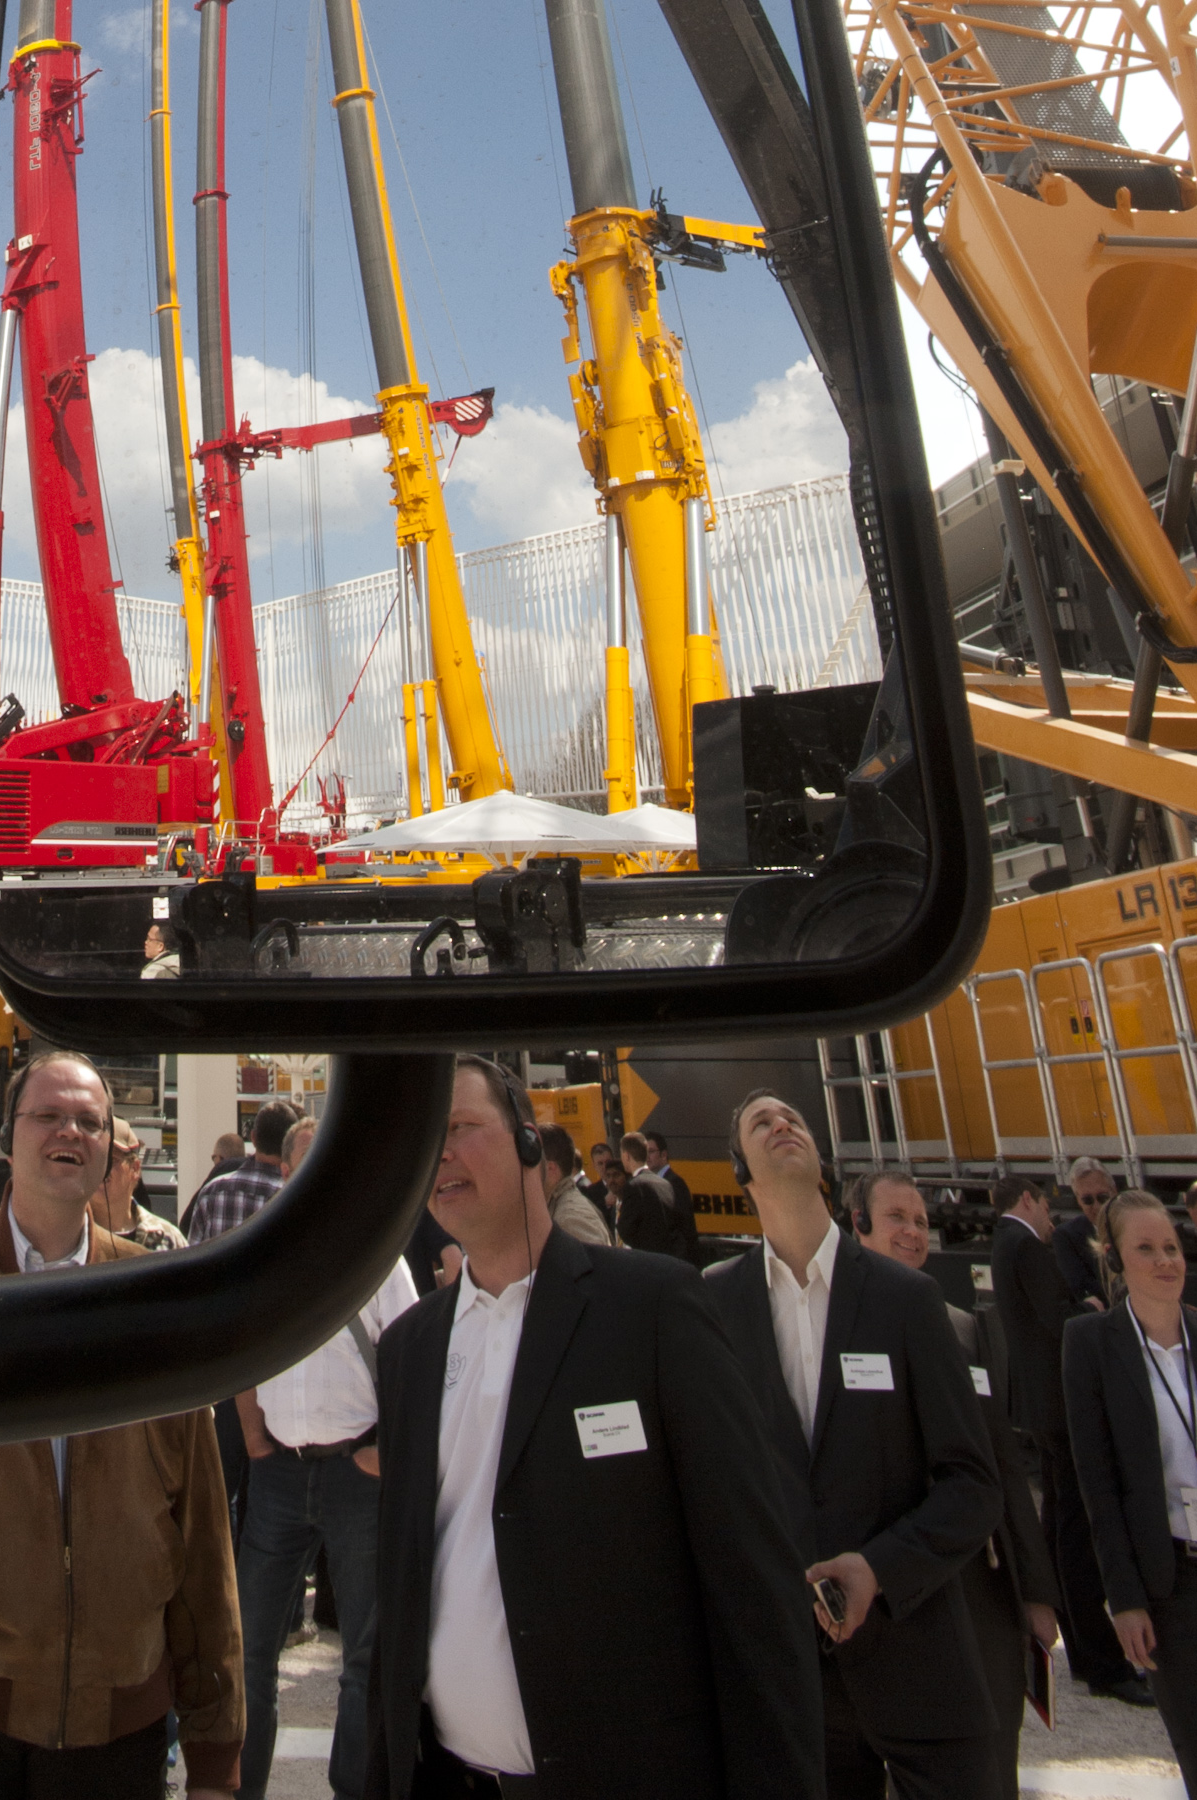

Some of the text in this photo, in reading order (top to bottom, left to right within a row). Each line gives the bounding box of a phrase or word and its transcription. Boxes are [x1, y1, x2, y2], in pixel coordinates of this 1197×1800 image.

[1117, 872, 1197, 922] LR 13
[693, 1194, 754, 1216] BHE
